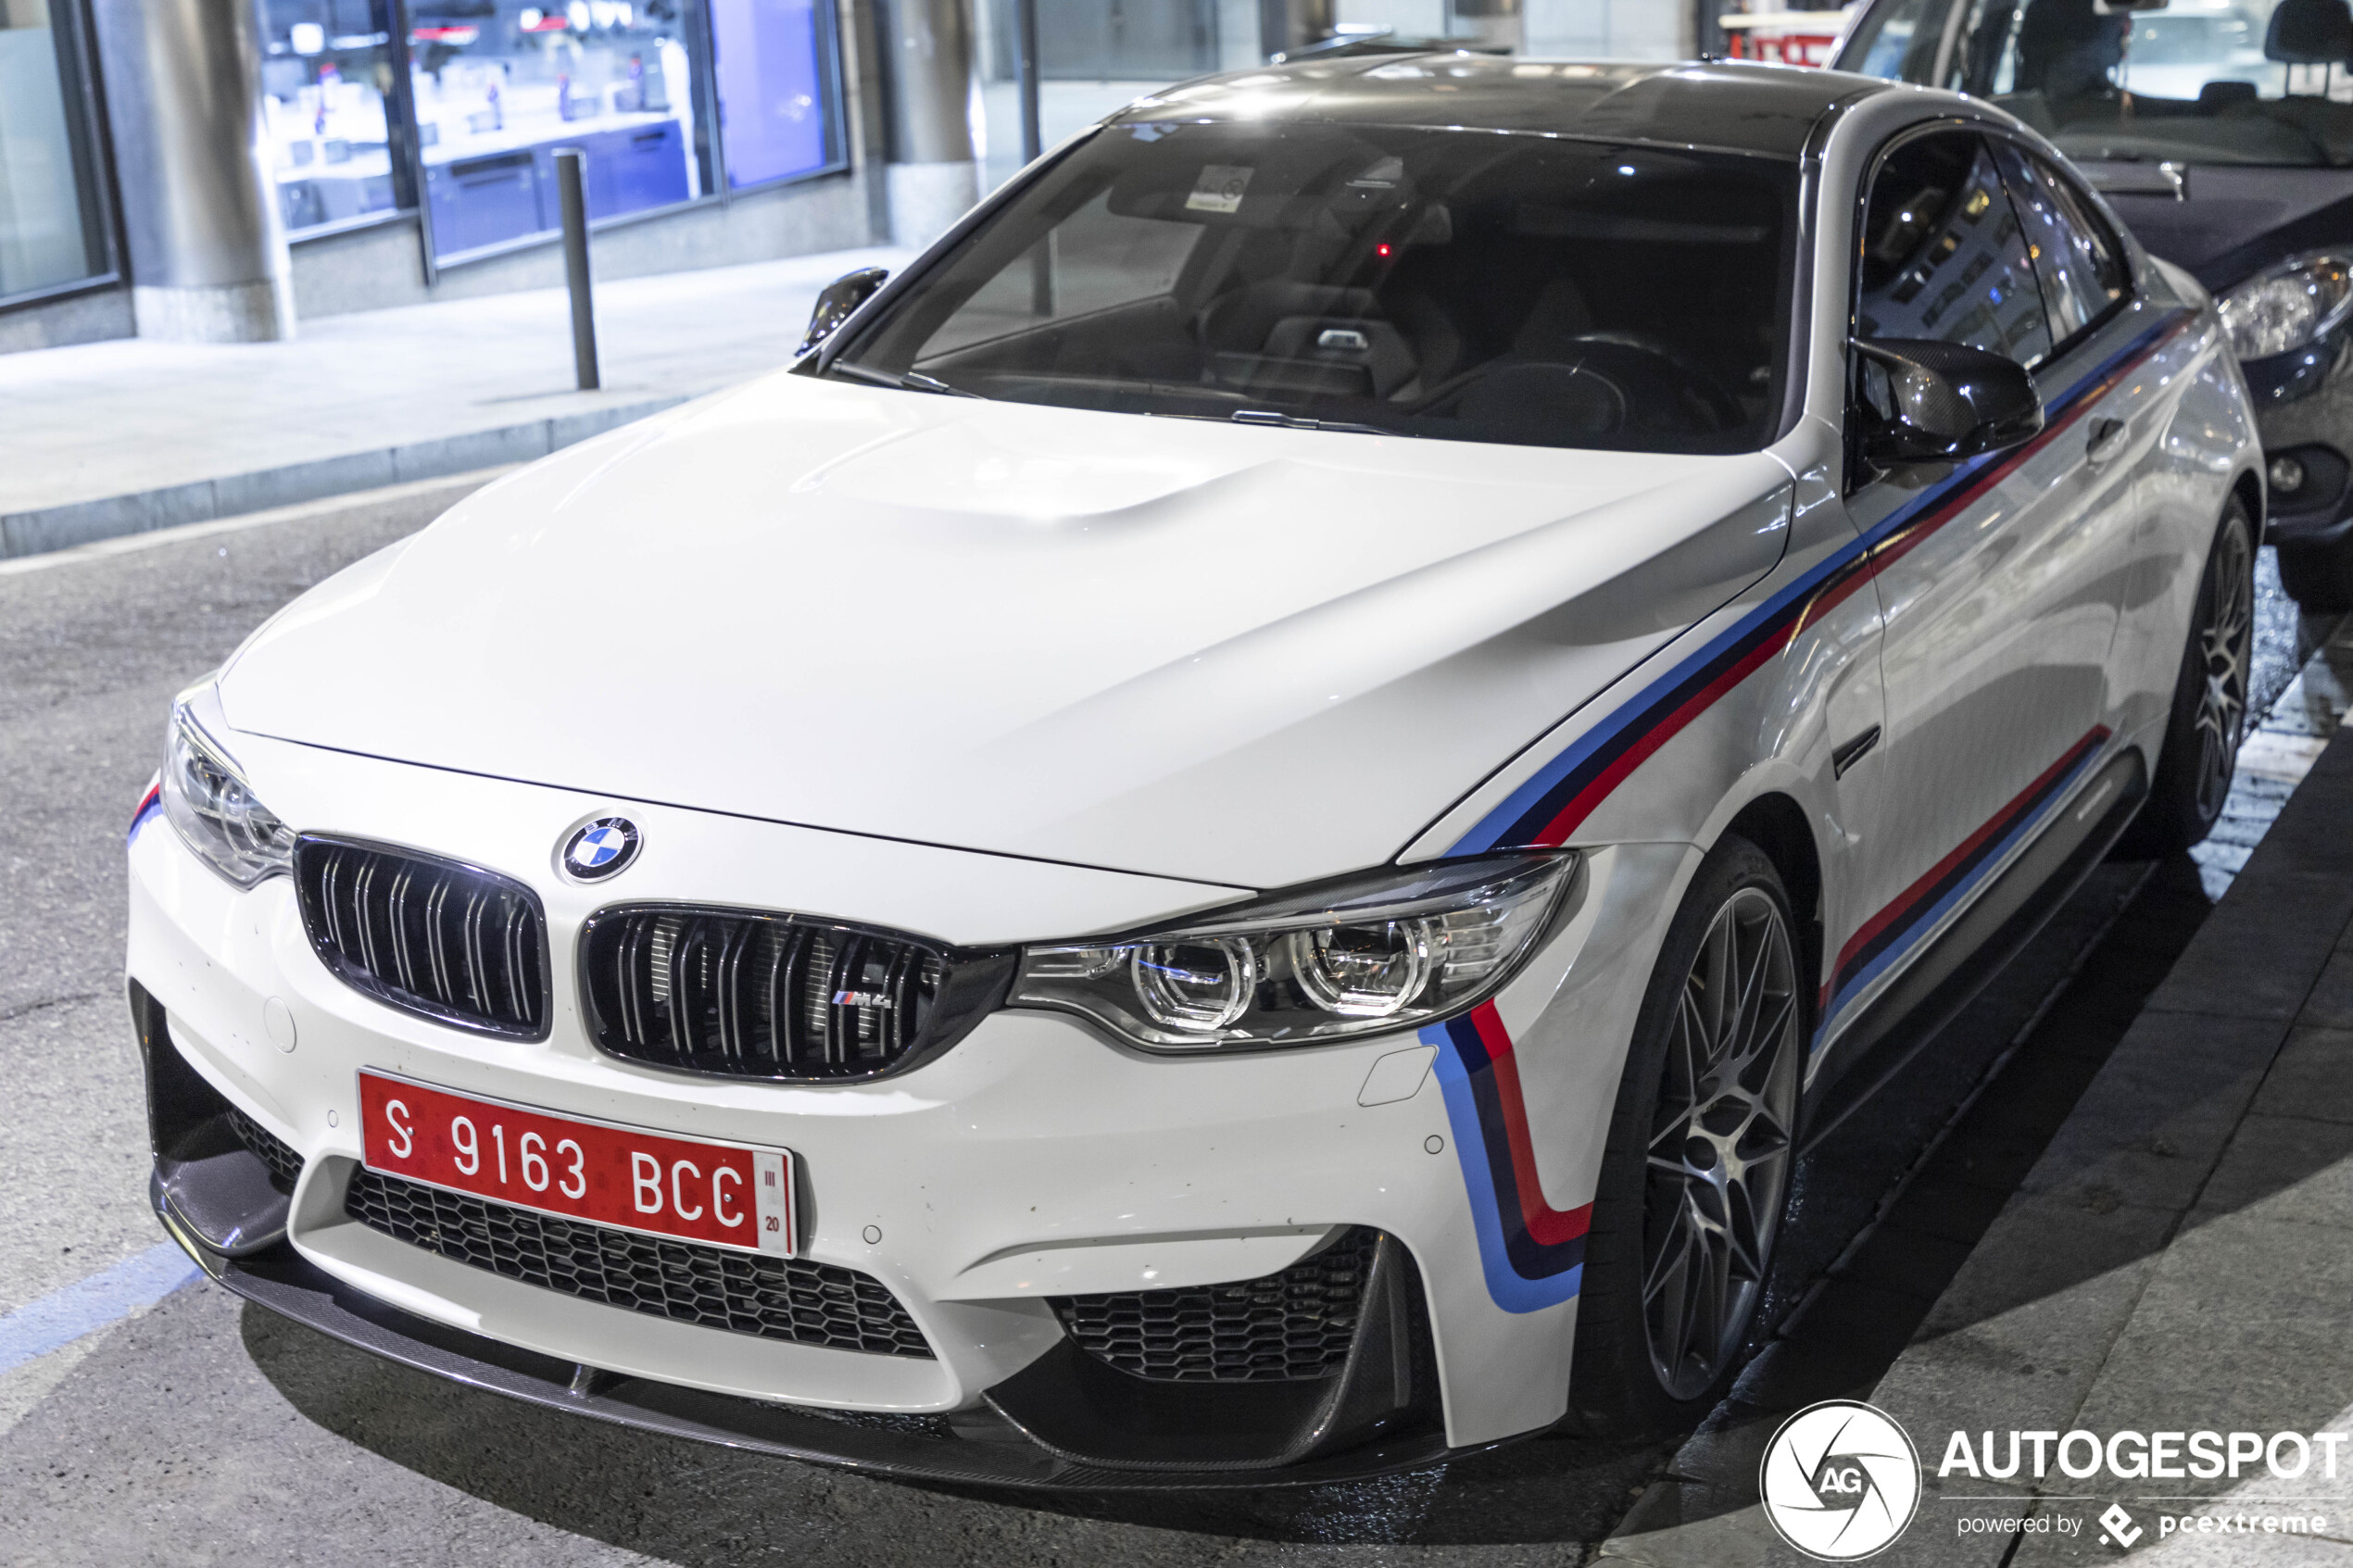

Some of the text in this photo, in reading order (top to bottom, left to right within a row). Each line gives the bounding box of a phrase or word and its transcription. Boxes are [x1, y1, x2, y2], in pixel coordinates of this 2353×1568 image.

[585, 817, 638, 842] BMW
[850, 991, 892, 1009] M4
[385, 1099, 744, 1228] S 9163 BCC
[765, 1215, 779, 1232] 20
